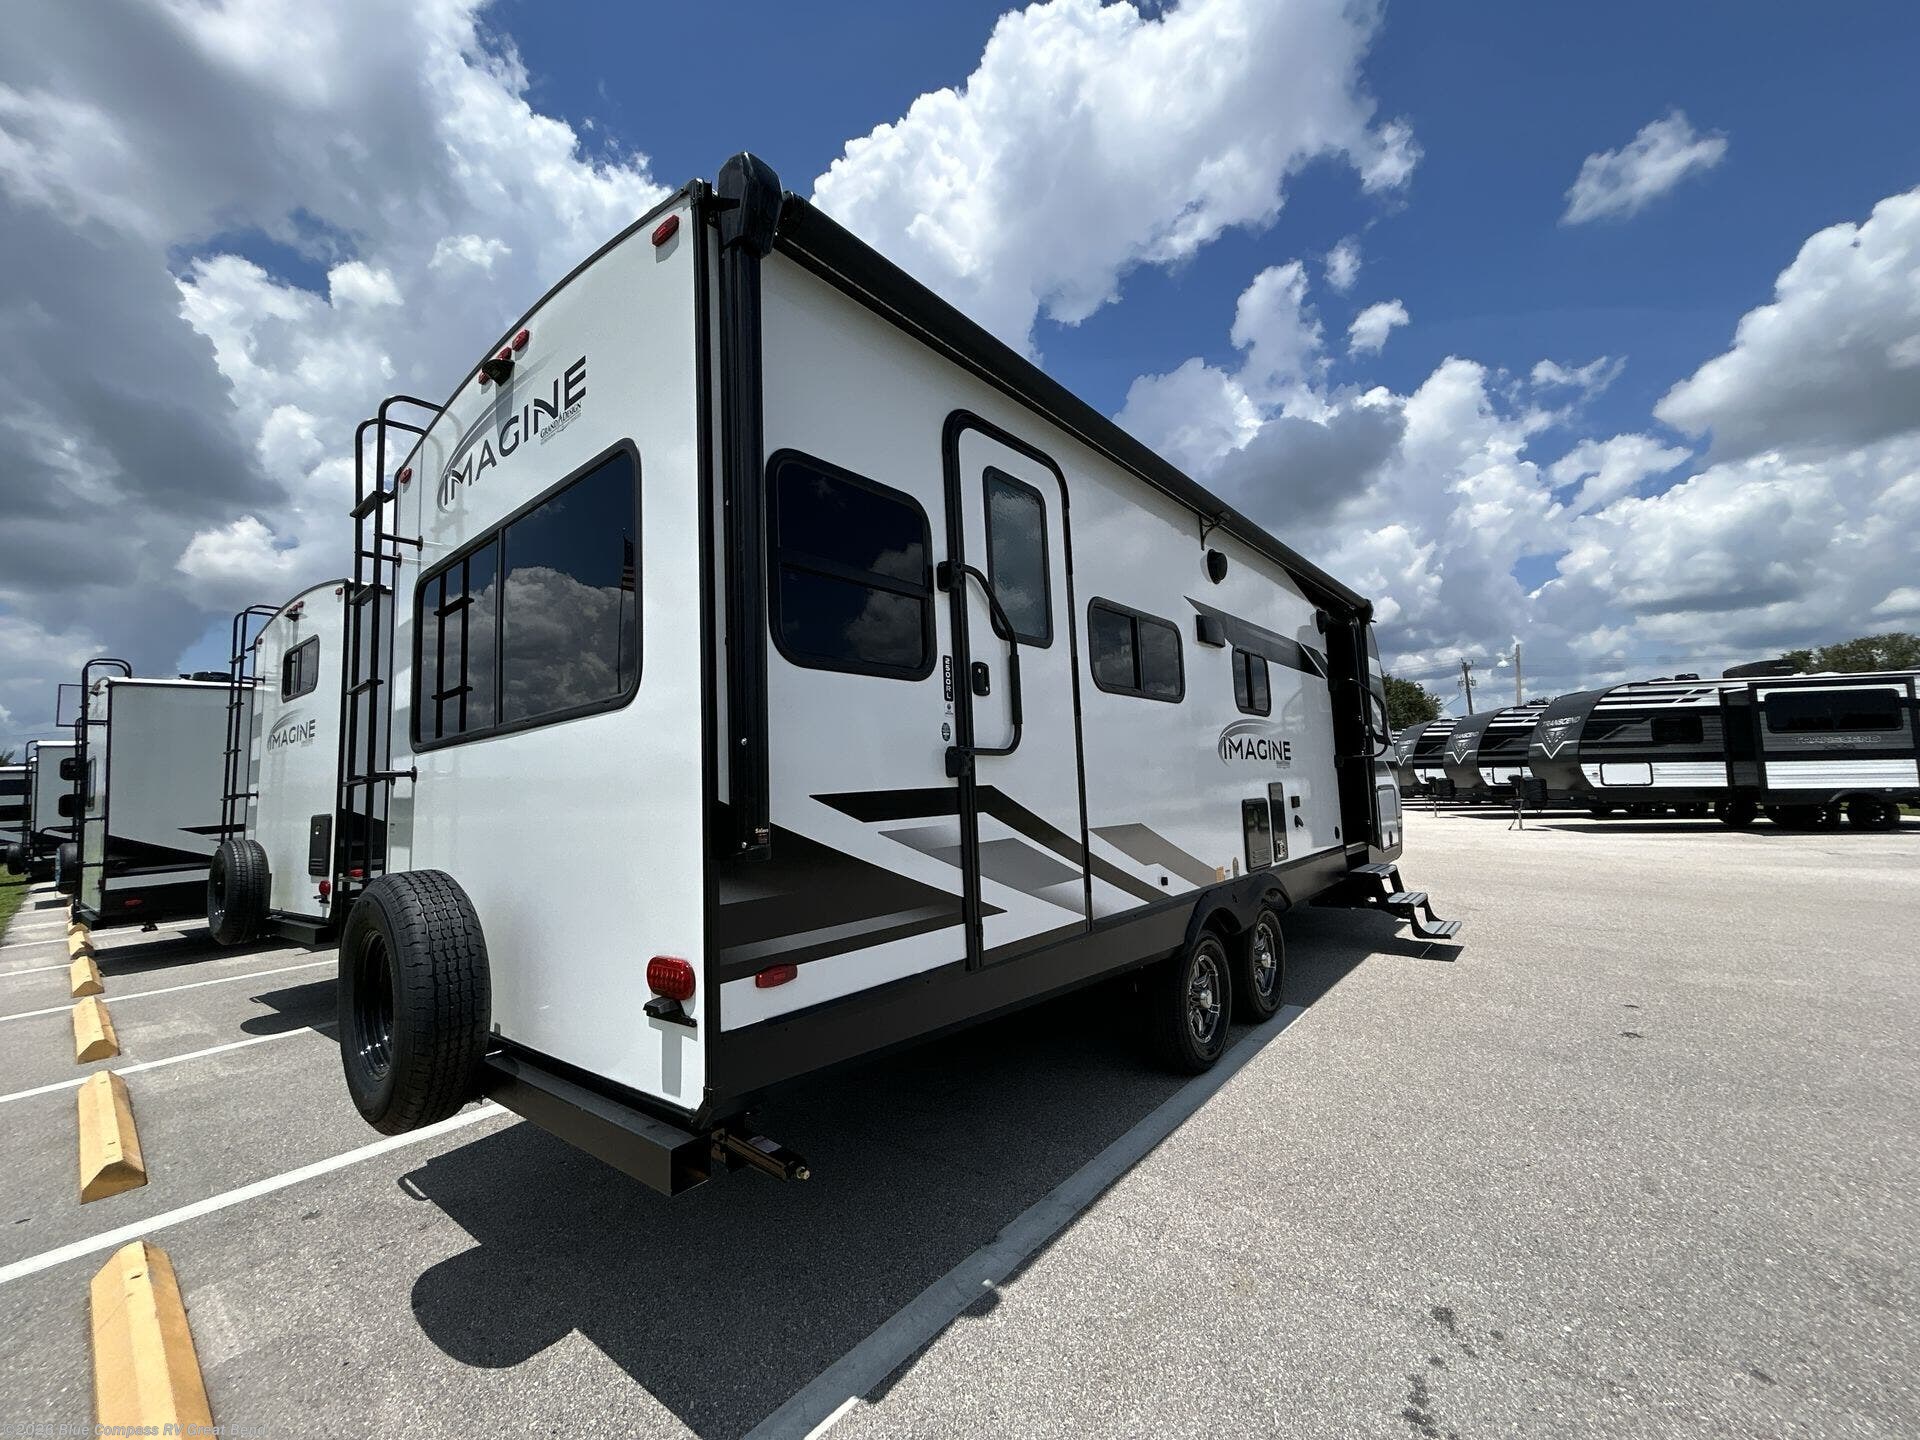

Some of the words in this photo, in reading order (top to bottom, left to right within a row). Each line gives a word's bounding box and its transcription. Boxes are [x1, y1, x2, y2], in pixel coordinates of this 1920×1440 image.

[444, 355, 586, 506] IMAGINE
[268, 719, 316, 751] IMAGINE
[1223, 736, 1291, 760] IMAGINE
